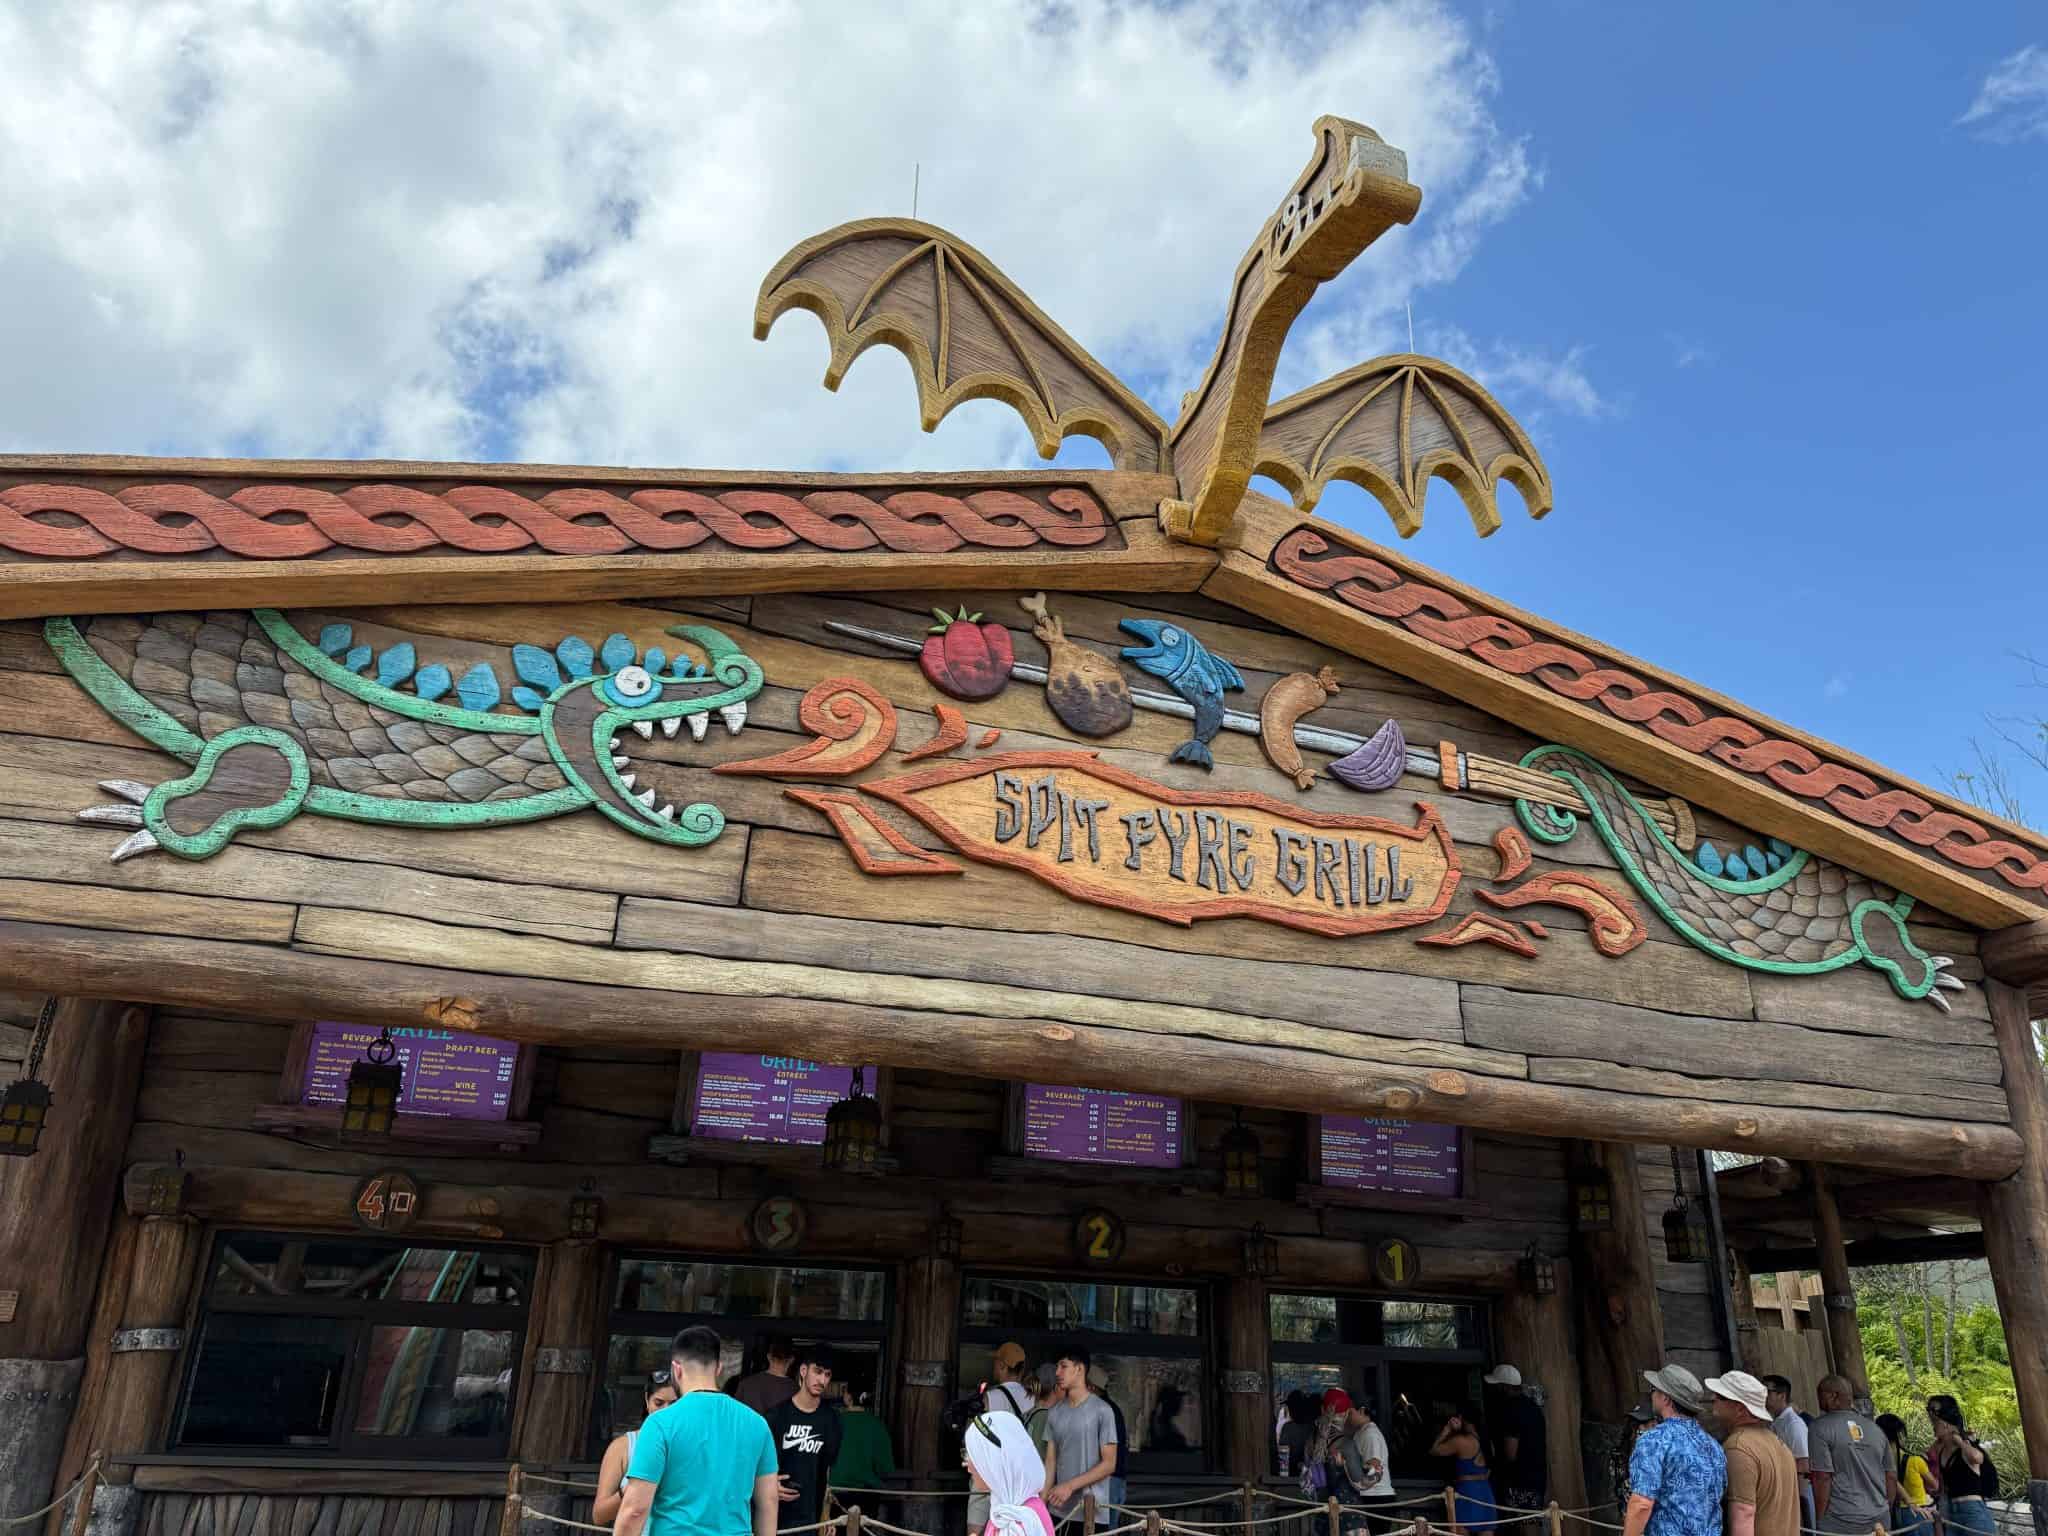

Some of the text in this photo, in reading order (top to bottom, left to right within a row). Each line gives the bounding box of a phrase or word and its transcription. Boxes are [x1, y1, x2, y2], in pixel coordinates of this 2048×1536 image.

[994, 772, 1414, 907] SPIT FYRE GRILL
[446, 1044, 474, 1054] DRAFT
[475, 1046, 498, 1056] BEER
[455, 1081, 477, 1090] WINE
[768, 1201, 793, 1247] 3
[1088, 1217, 1110, 1258] 2
[1386, 1245, 1403, 1281] 1
[786, 1424, 813, 1438] JUST
[798, 1439, 825, 1454] DO IT
